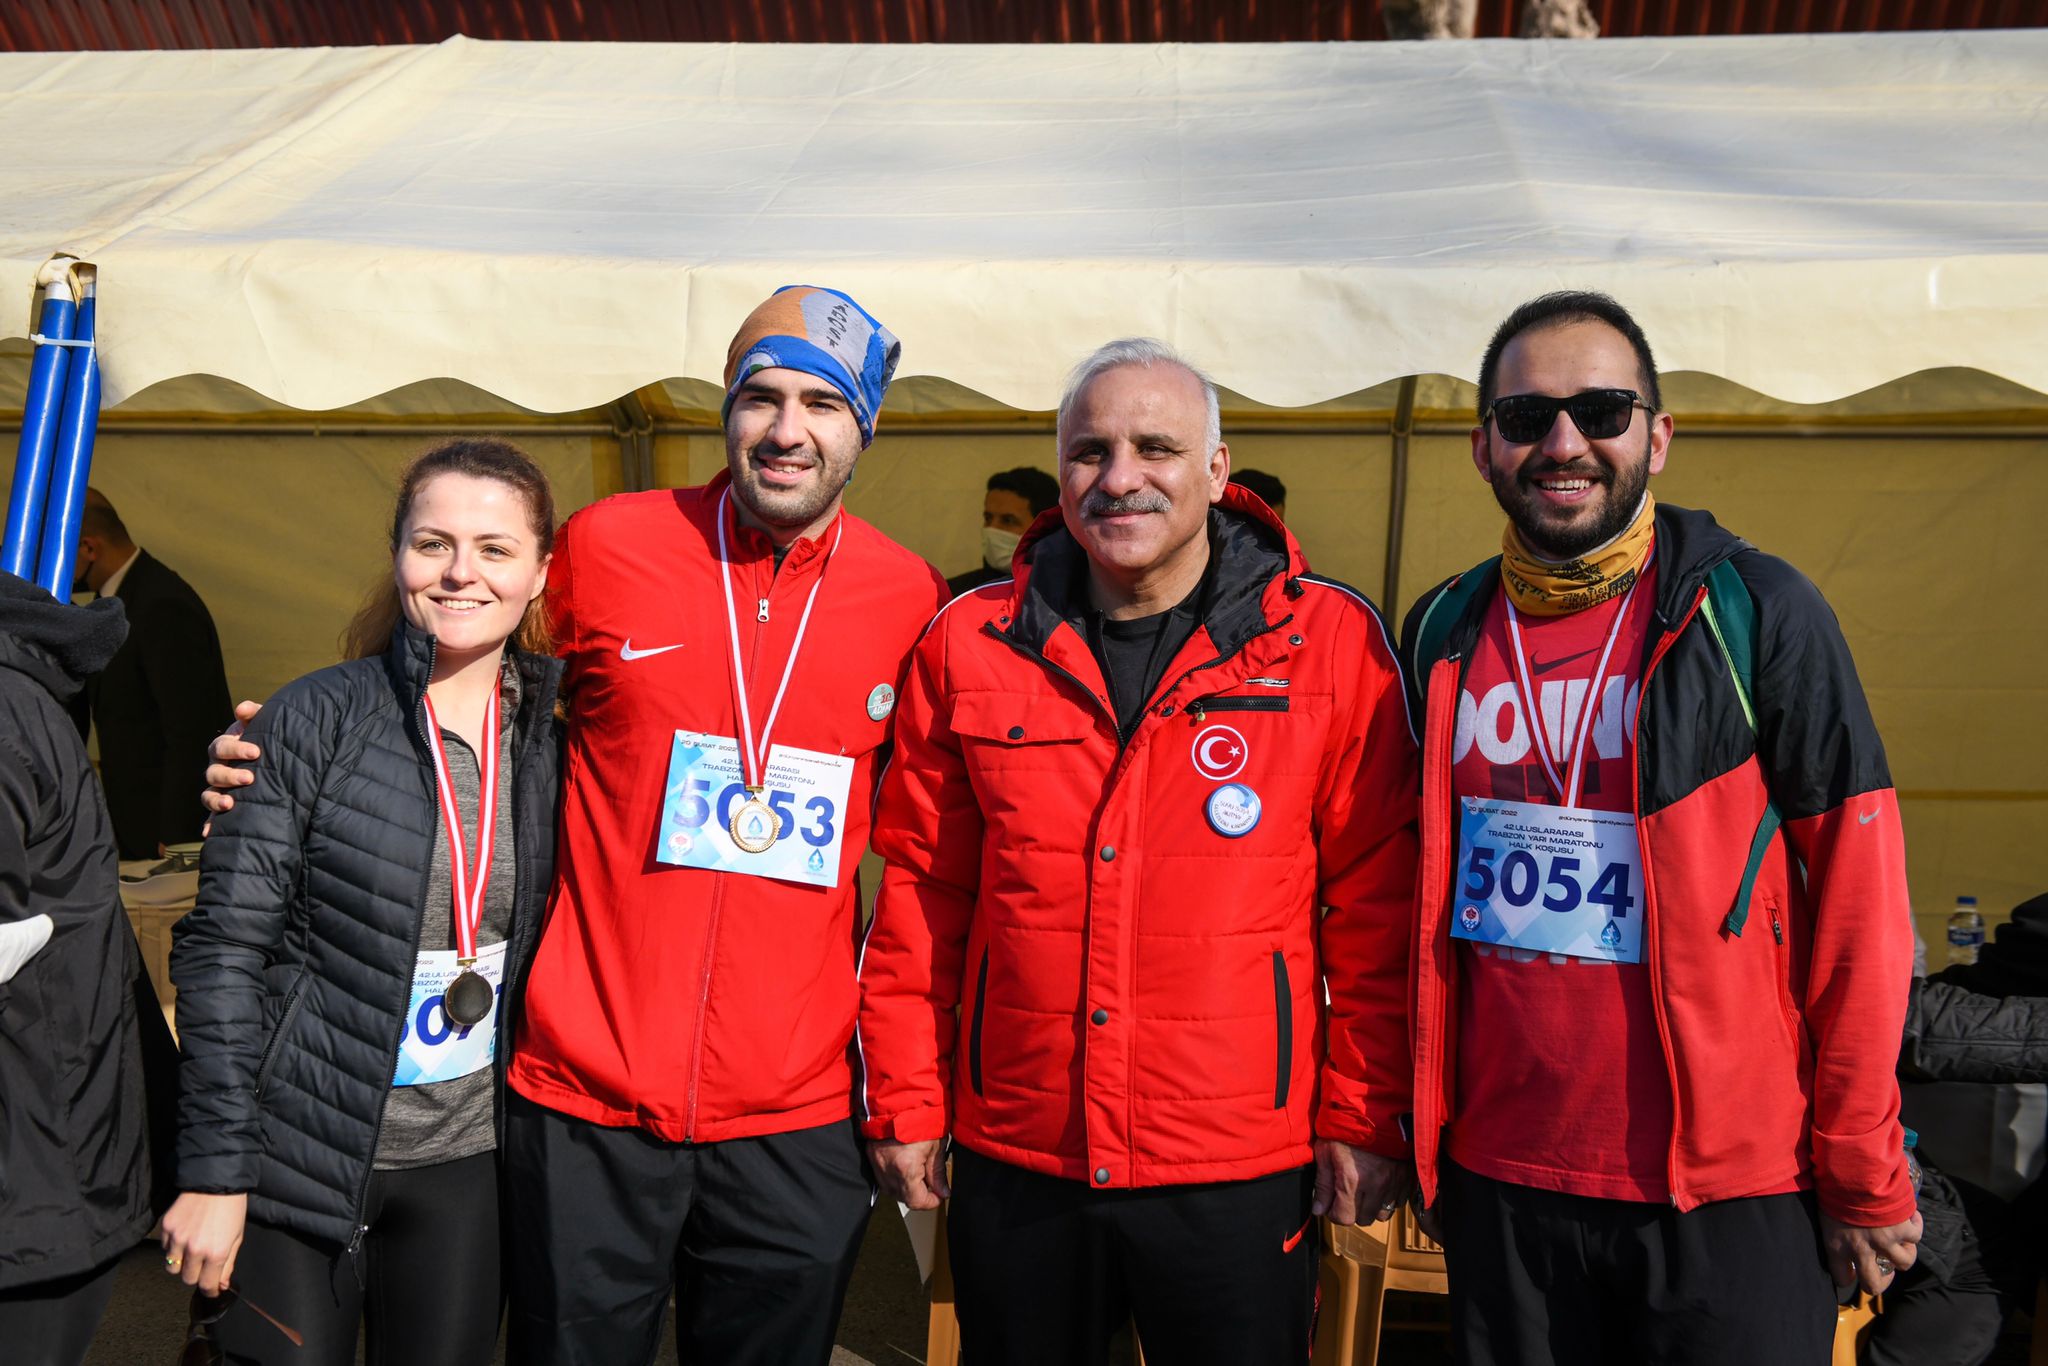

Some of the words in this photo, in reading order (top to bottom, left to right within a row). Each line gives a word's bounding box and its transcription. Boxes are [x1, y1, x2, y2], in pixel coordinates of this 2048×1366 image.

[1501, 809, 1518, 817] 2022
[1503, 823, 1585, 838] 42.ULUSLARARASI
[1487, 829, 1525, 840] TRABZON
[1528, 834, 1547, 843] YARI
[1549, 837, 1604, 849] MARATONU
[1508, 841, 1533, 850] HALK
[1535, 844, 1575, 855] KOŞUSU
[1464, 846, 1635, 918] 5054
